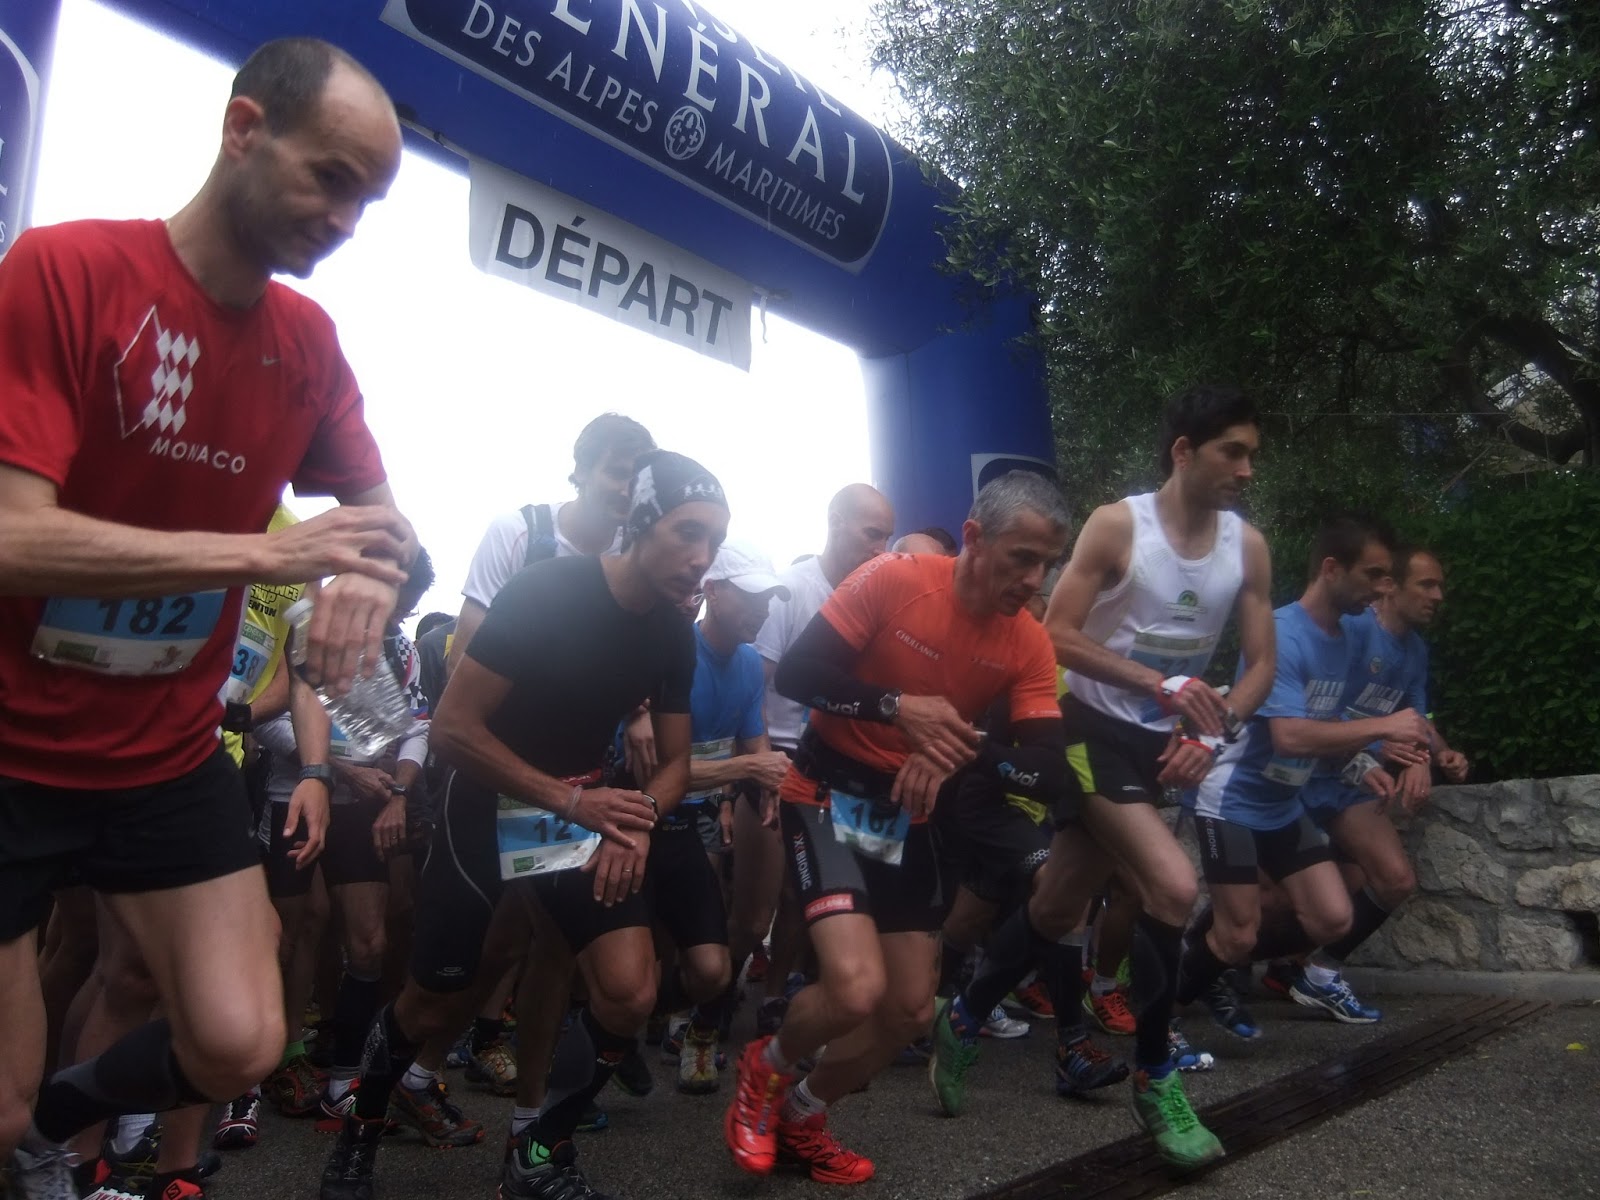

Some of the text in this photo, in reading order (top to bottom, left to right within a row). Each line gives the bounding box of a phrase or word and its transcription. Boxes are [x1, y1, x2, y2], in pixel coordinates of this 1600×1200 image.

[462, 0, 543, 67] DES
[547, 52, 659, 134] ALPES
[704, 142, 846, 240] MARITIMES
[495, 203, 733, 346] DÉPART
[149, 437, 246, 474] MONACO
[98, 595, 195, 635] 182
